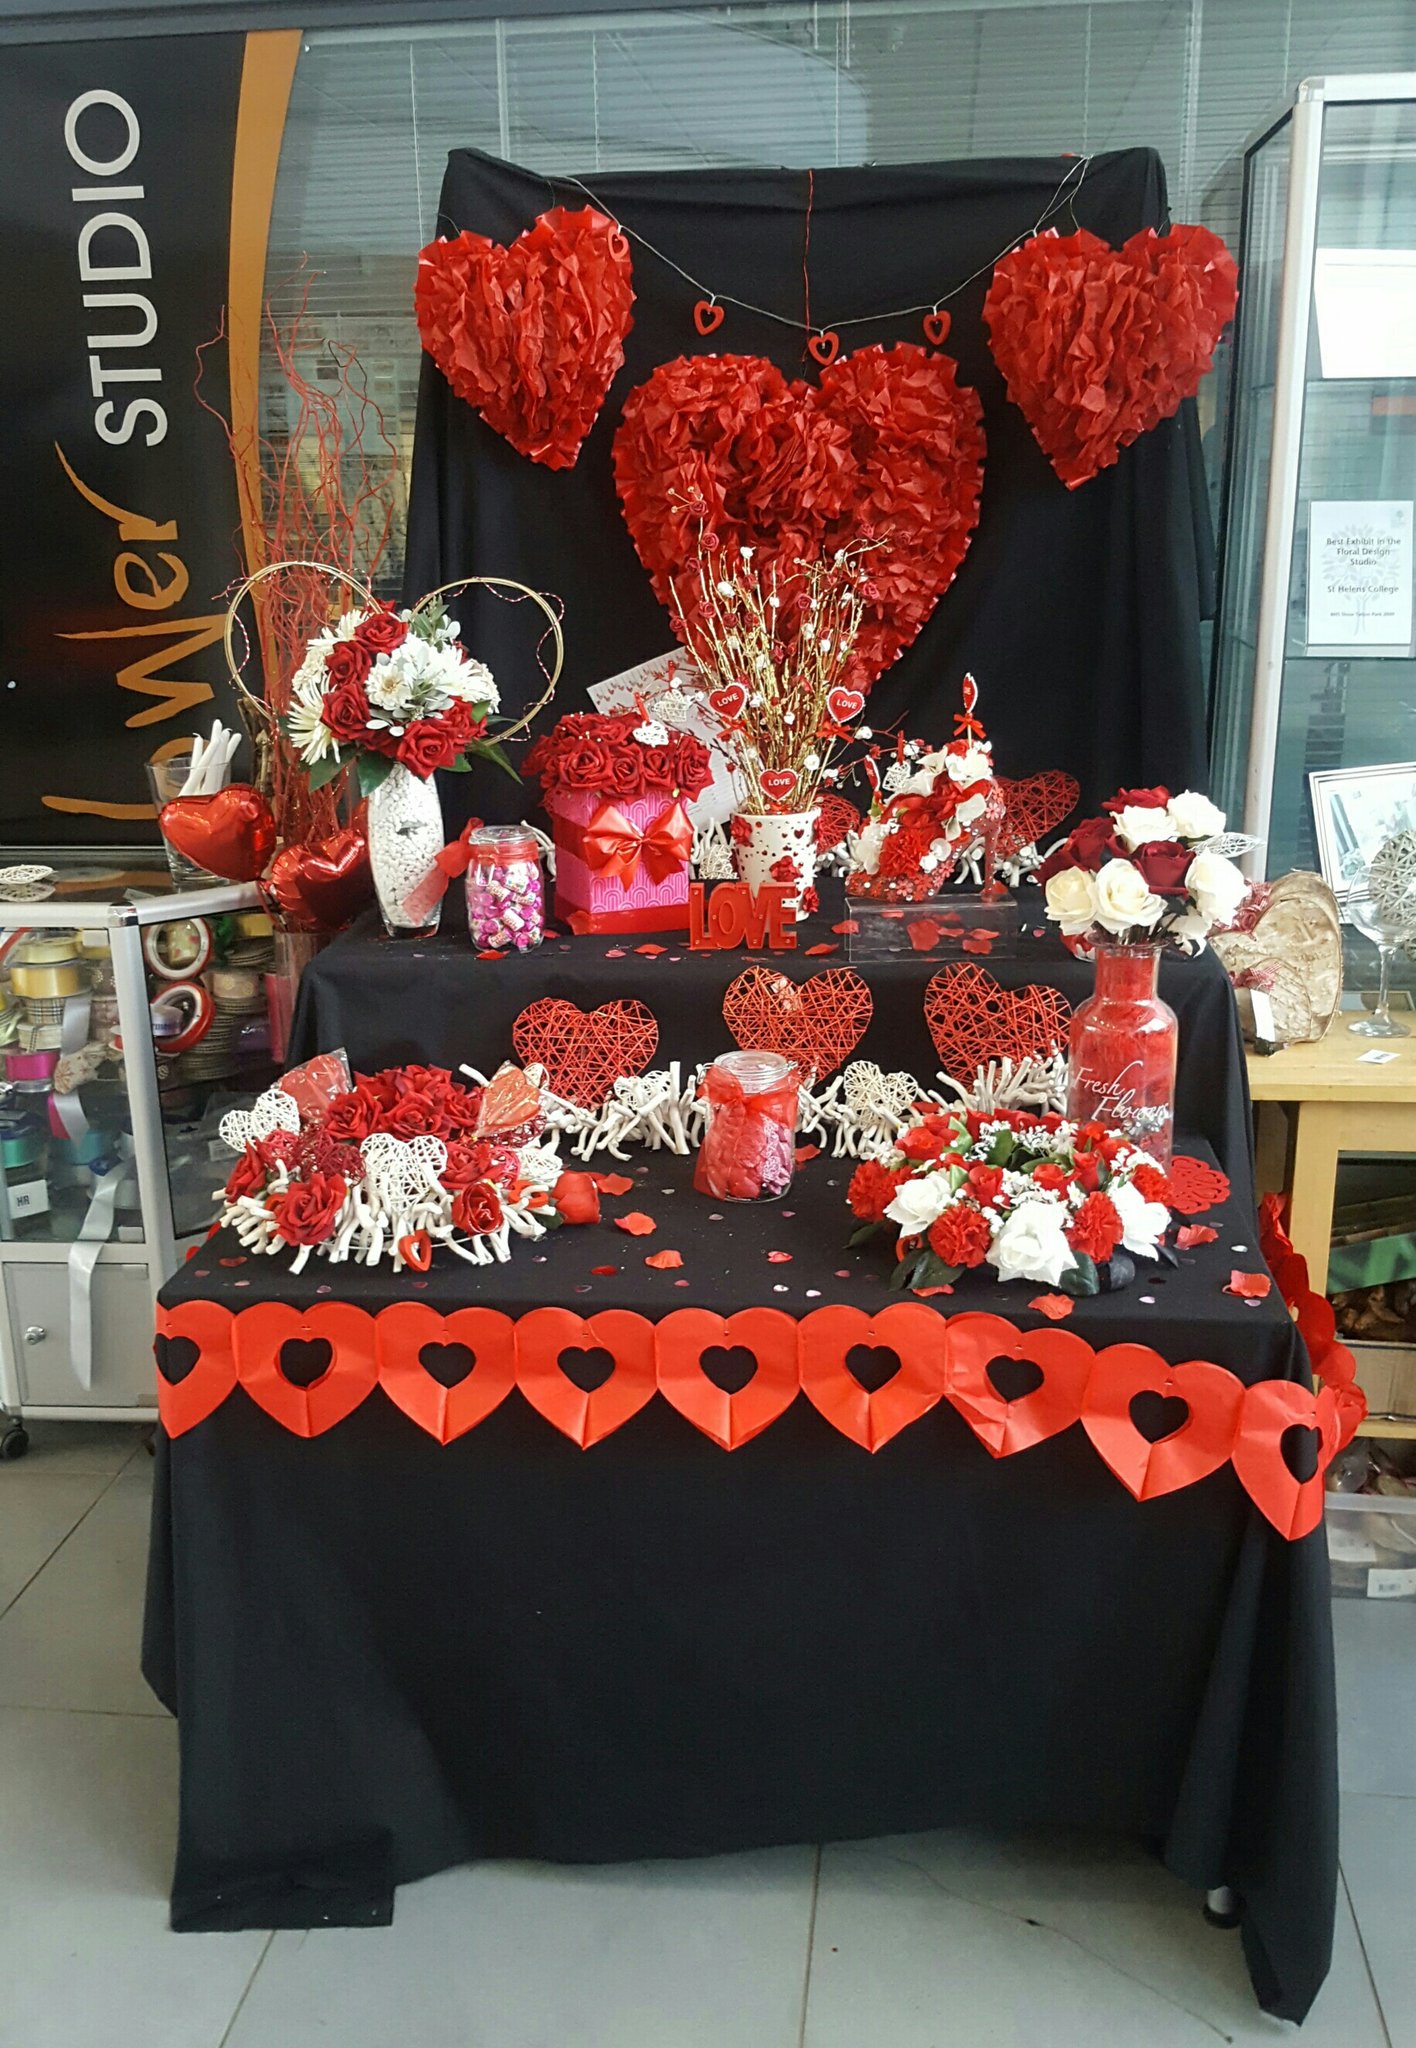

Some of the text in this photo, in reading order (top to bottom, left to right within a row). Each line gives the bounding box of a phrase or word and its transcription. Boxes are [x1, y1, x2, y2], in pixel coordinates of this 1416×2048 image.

[64, 88, 168, 448] STUDIO
[1326, 537, 1401, 546] Best Exhibit in the
[1336, 547, 1391, 558] Floral Design
[1350, 558, 1377, 566] Studio
[1327, 585, 1400, 595] St Helens College
[716, 692, 739, 707] LOVE
[836, 698, 858, 710] LOVE
[768, 777, 791, 787] LOVE
[689, 881, 797, 950] LOVE
[1073, 1059, 1144, 1096] Fresh
[1091, 1088, 1170, 1121] Flowers
